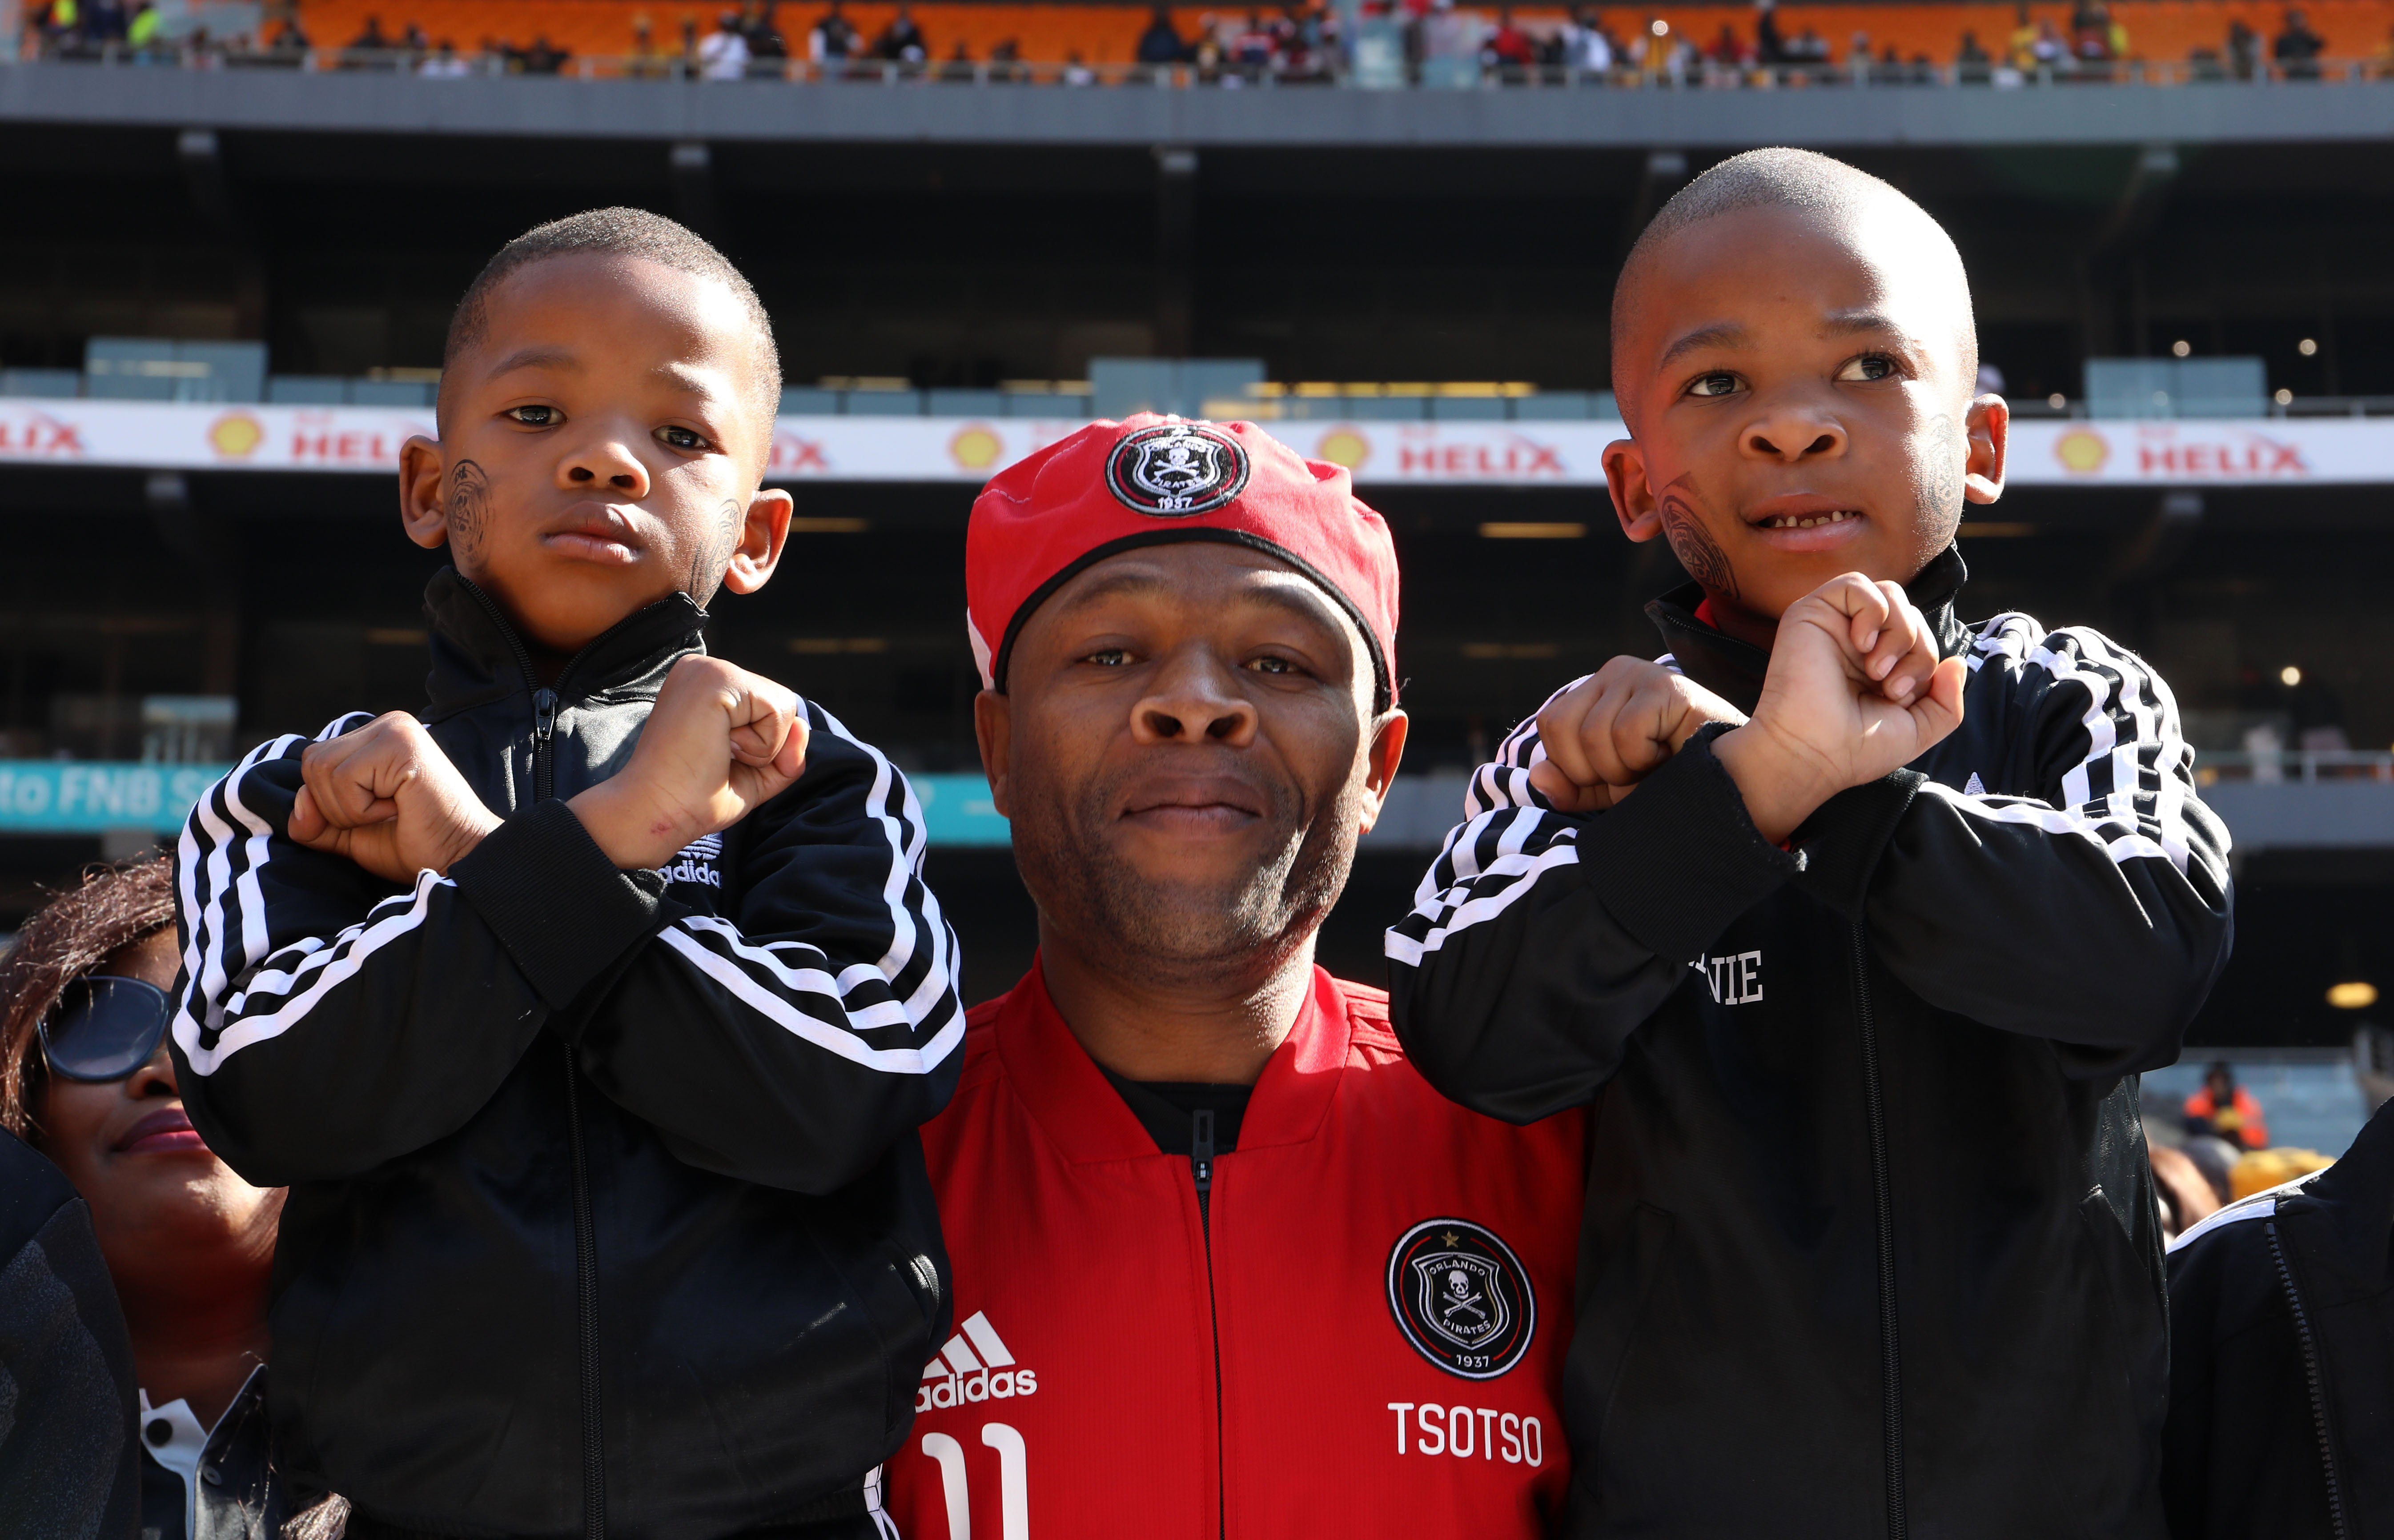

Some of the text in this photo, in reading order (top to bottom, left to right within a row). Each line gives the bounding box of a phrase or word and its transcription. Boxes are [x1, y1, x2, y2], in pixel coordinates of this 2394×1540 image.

[1399, 445, 1565, 476] HELIX
[2139, 443, 2310, 476] HELIX
[1157, 496, 1193, 509] 1937
[58, 768, 161, 817] FNB
[657, 860, 722, 889] adida
[1430, 1259, 1486, 1277] ORLANDO
[1442, 1318, 1491, 1335] PIRATES
[1456, 1354, 1490, 1368] 1937
[915, 1367, 1037, 1414] adidas
[1387, 1402, 1542, 1467] TSOTSO
[921, 1422, 1029, 1540] 11
